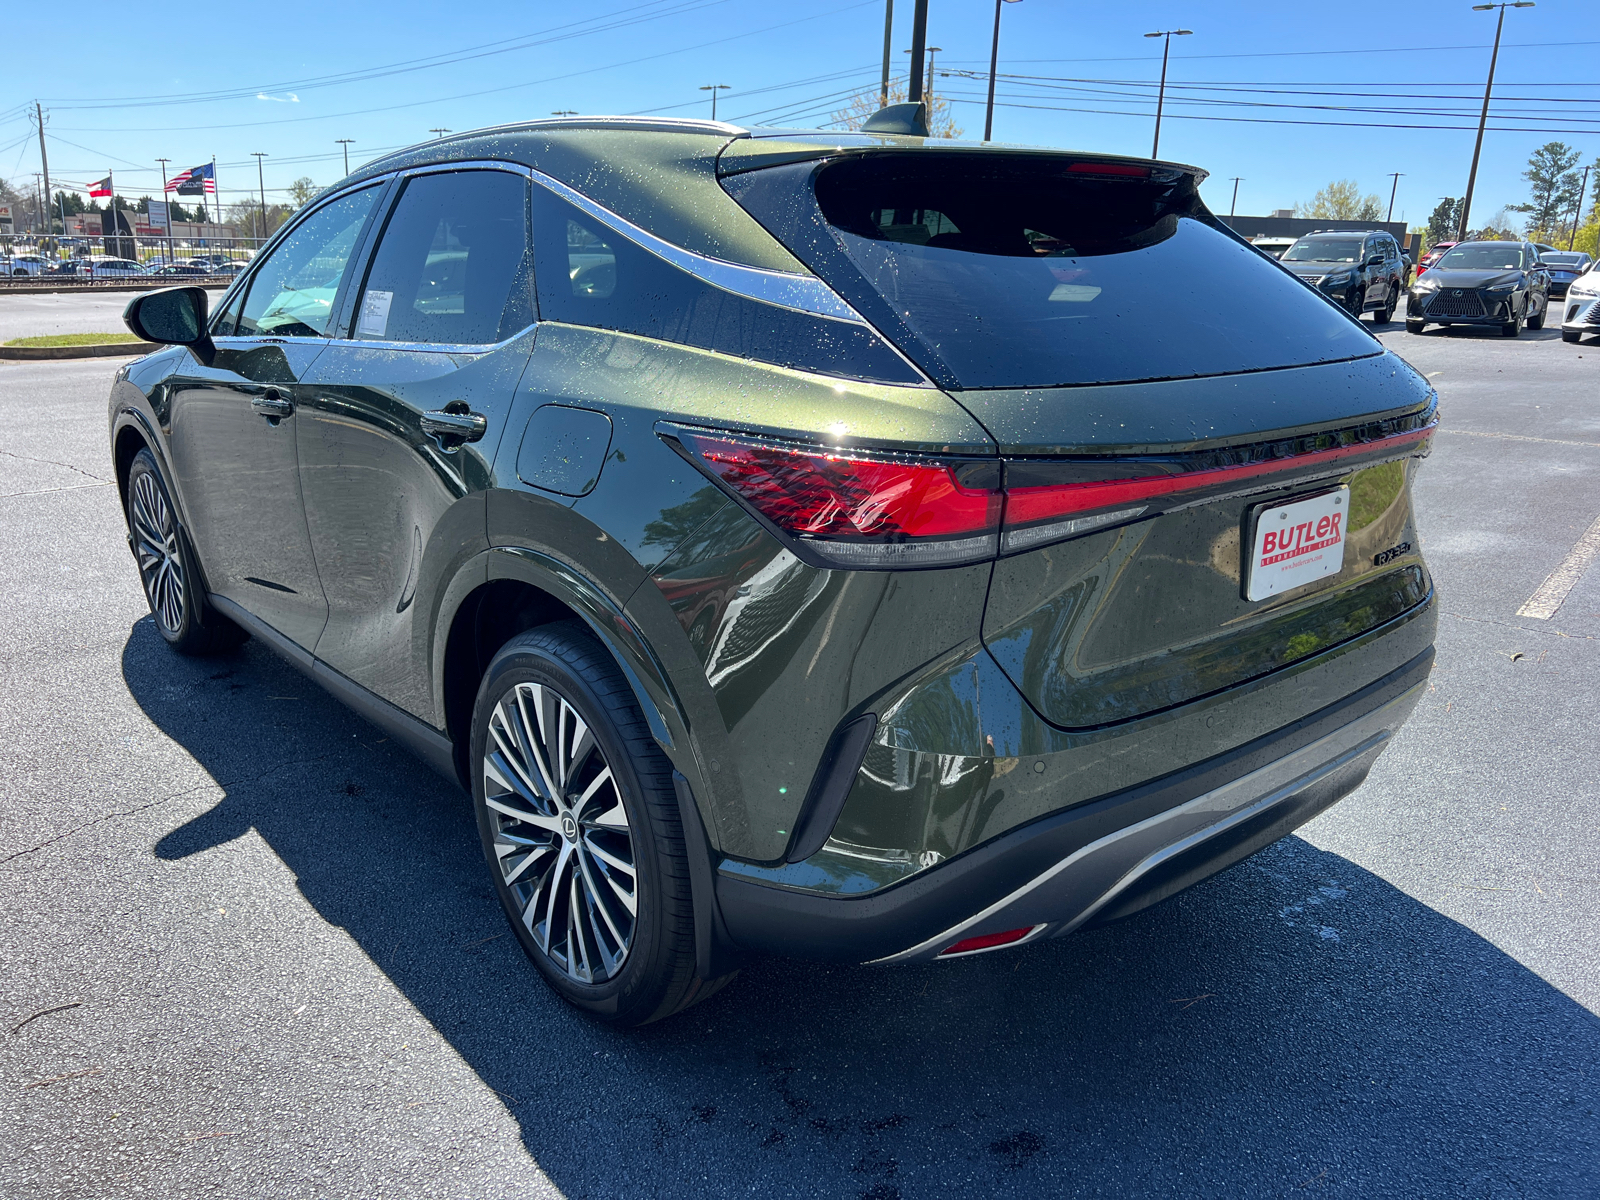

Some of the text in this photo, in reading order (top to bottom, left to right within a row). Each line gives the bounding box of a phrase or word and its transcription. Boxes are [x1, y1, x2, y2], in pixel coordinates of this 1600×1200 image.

[1261, 535, 1341, 566] AUTOMOTIVE GROUP
[1281, 554, 1323, 572] www.butlercars.com
